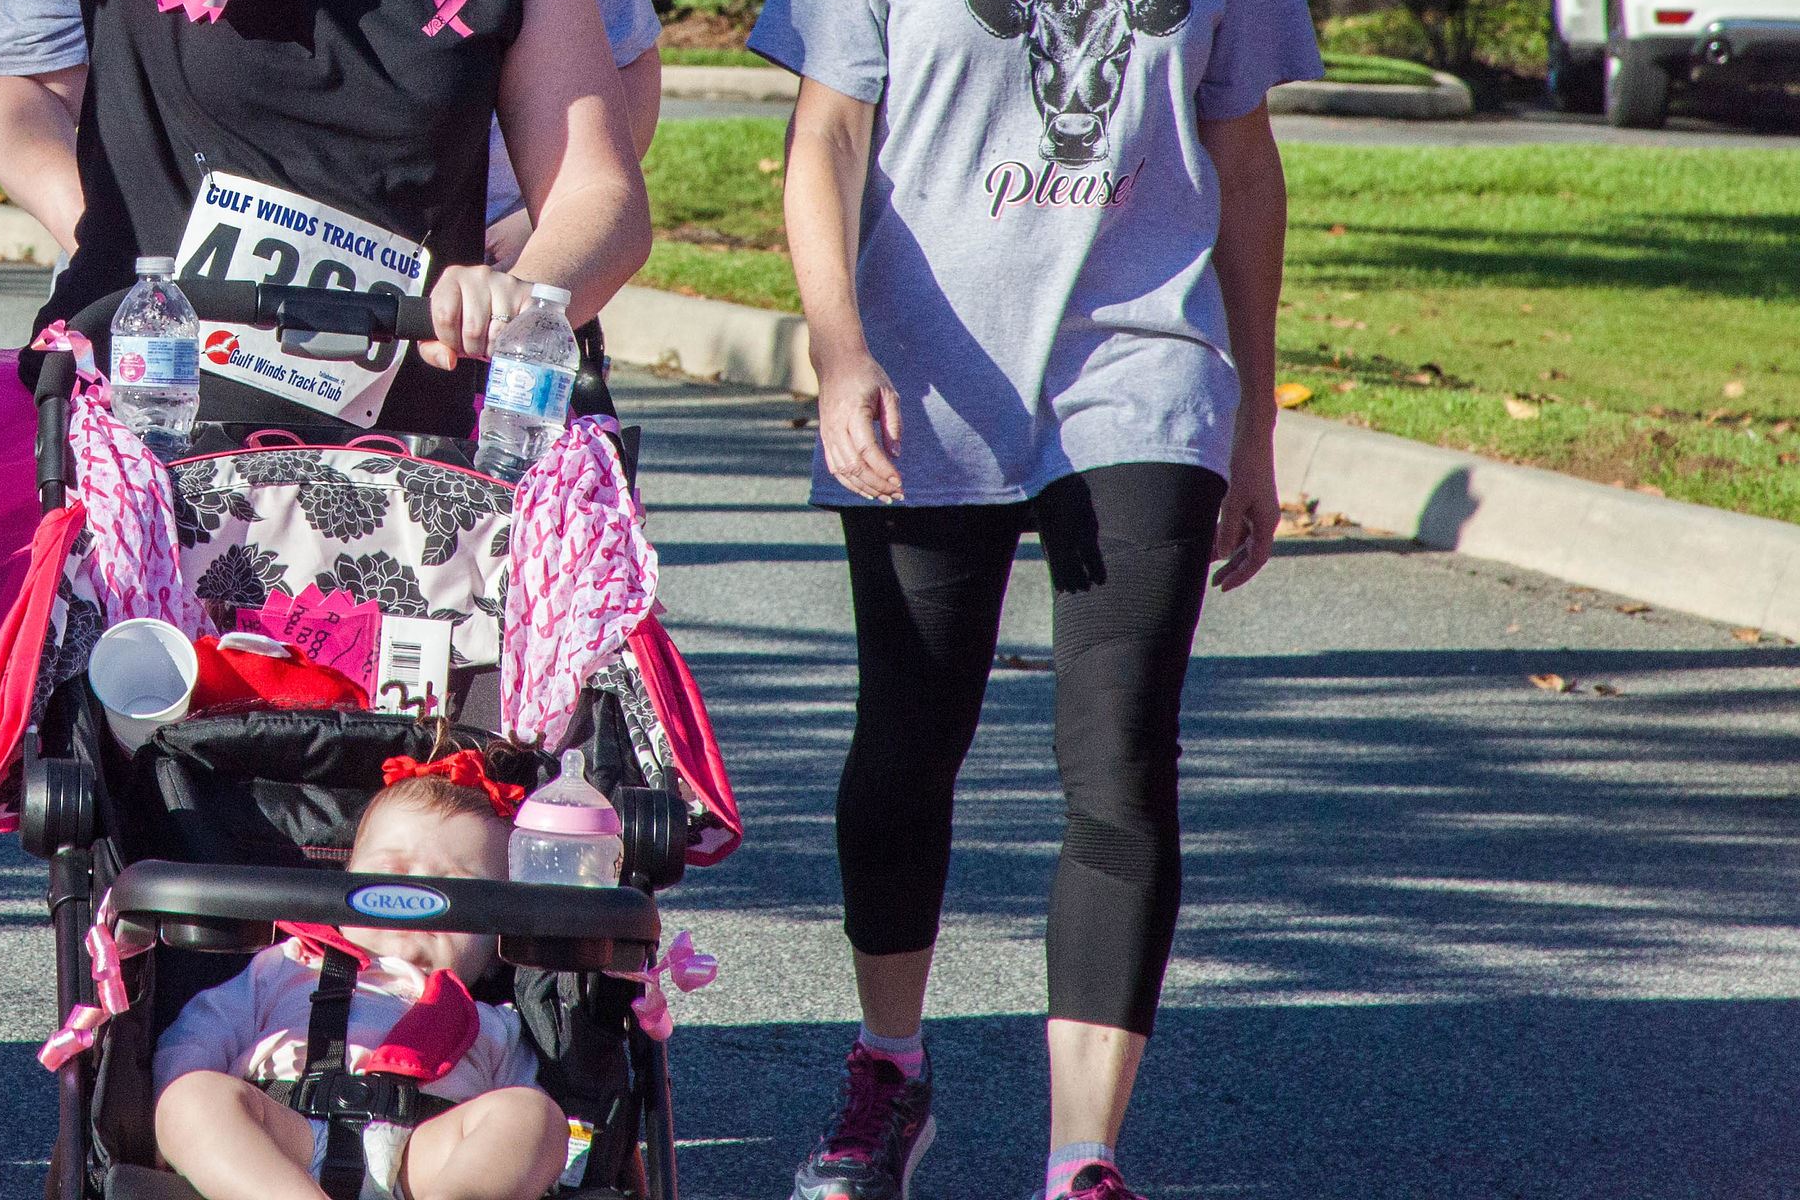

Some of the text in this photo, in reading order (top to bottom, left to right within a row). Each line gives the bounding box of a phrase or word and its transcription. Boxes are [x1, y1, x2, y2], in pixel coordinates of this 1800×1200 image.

[206, 187, 421, 280] GULF WINDS TRACK CLUB
[230, 349, 255, 369] Gulf
[253, 356, 287, 382] Winds
[287, 369, 318, 393] Track
[317, 380, 343, 402] Club
[362, 892, 436, 911] GRACO
